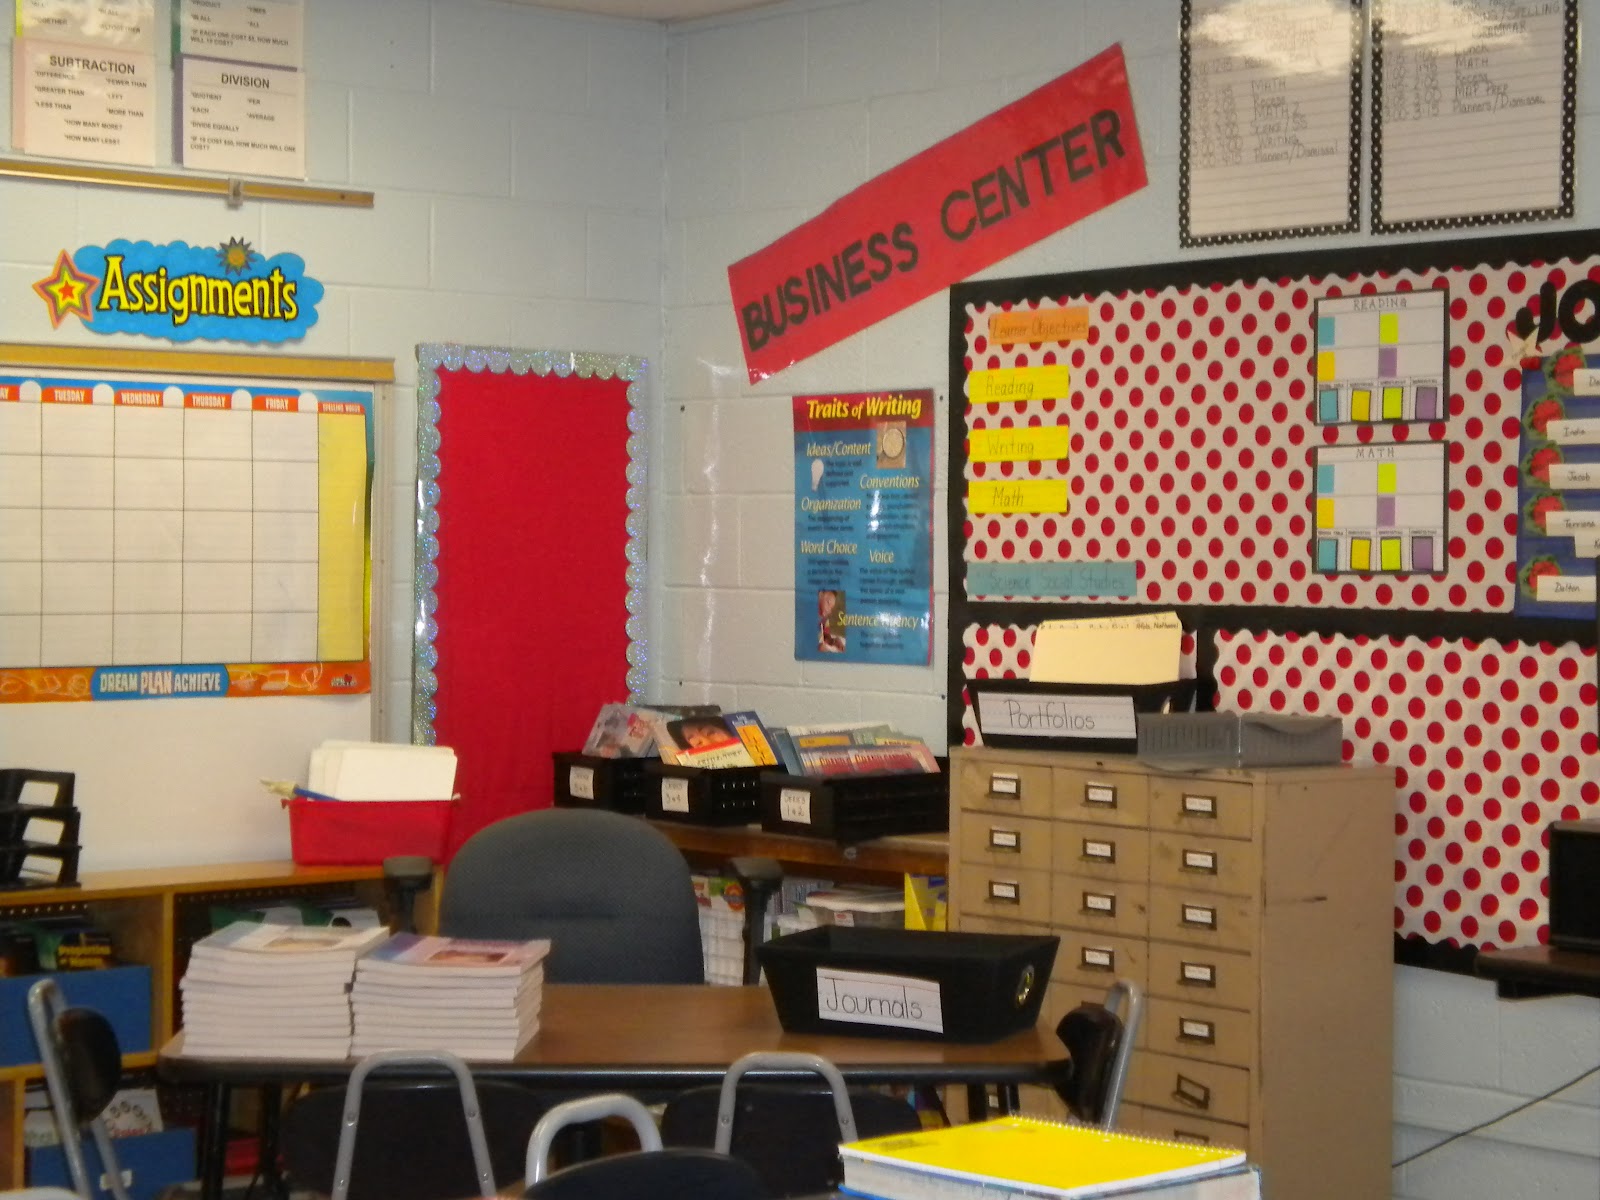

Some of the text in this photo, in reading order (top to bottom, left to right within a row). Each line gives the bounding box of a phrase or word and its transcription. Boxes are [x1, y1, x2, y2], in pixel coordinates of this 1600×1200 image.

[50, 55, 136, 75] SUBTRACTION
[131, 80, 148, 88] THAN
[221, 73, 270, 90] DIVISION
[68, 88, 85, 96] THAN
[54, 102, 72, 110] THAN
[128, 109, 145, 118] THAN
[741, 108, 1126, 353] BUSINESS CENTER
[97, 255, 299, 326] Assignments
[1353, 298, 1408, 312] READING
[1031, 315, 1088, 337] Objectives
[985, 374, 1035, 398] Reading
[54, 389, 85, 402] TUESDAY
[121, 392, 160, 405] WEDNESDAY
[191, 395, 226, 408] THURSDAY
[265, 398, 289, 410] FRIDAY
[806, 394, 922, 420] Traits of Writing
[806, 441, 871, 458] Ideas/Content
[986, 434, 1035, 458] Writing
[1356, 447, 1395, 459] MATH
[860, 474, 920, 490] Conventions
[1567, 471, 1591, 482] Jacob
[992, 485, 1025, 508] Math
[801, 497, 861, 514] Organization
[800, 539, 858, 555] Word Choice
[869, 549, 895, 564] Voice
[837, 610, 878, 627] Sentence
[100, 670, 221, 696] DREAM PLAN ACHIEVE
[1003, 699, 1096, 731] Portfolios
[825, 976, 923, 1020] Journals
